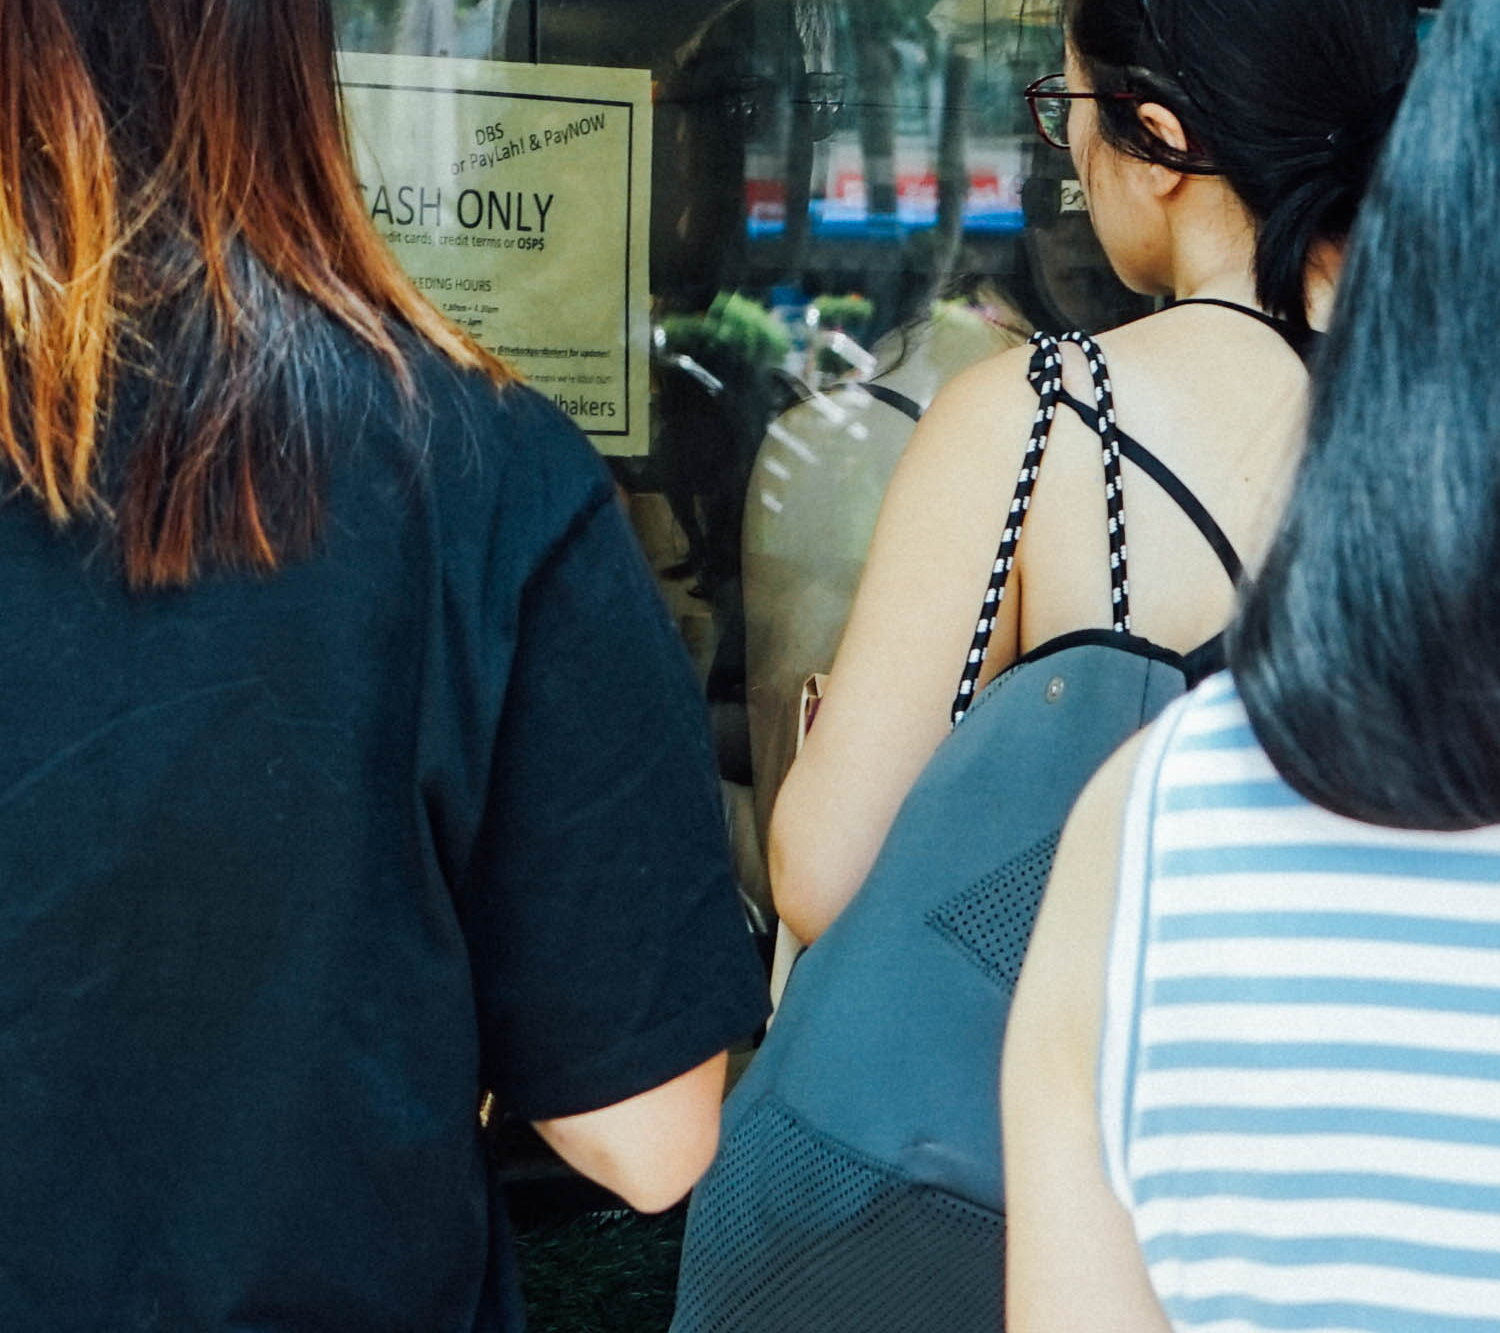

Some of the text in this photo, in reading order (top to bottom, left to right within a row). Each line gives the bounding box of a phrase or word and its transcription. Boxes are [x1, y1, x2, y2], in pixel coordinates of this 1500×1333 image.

[450, 113, 607, 176] or PayLah! & PayNOW
[475, 122, 505, 146] DBS
[456, 188, 555, 234] ONLY
[471, 235, 502, 249] terms
[503, 238, 517, 250] or
[456, 278, 492, 292] HOURS
